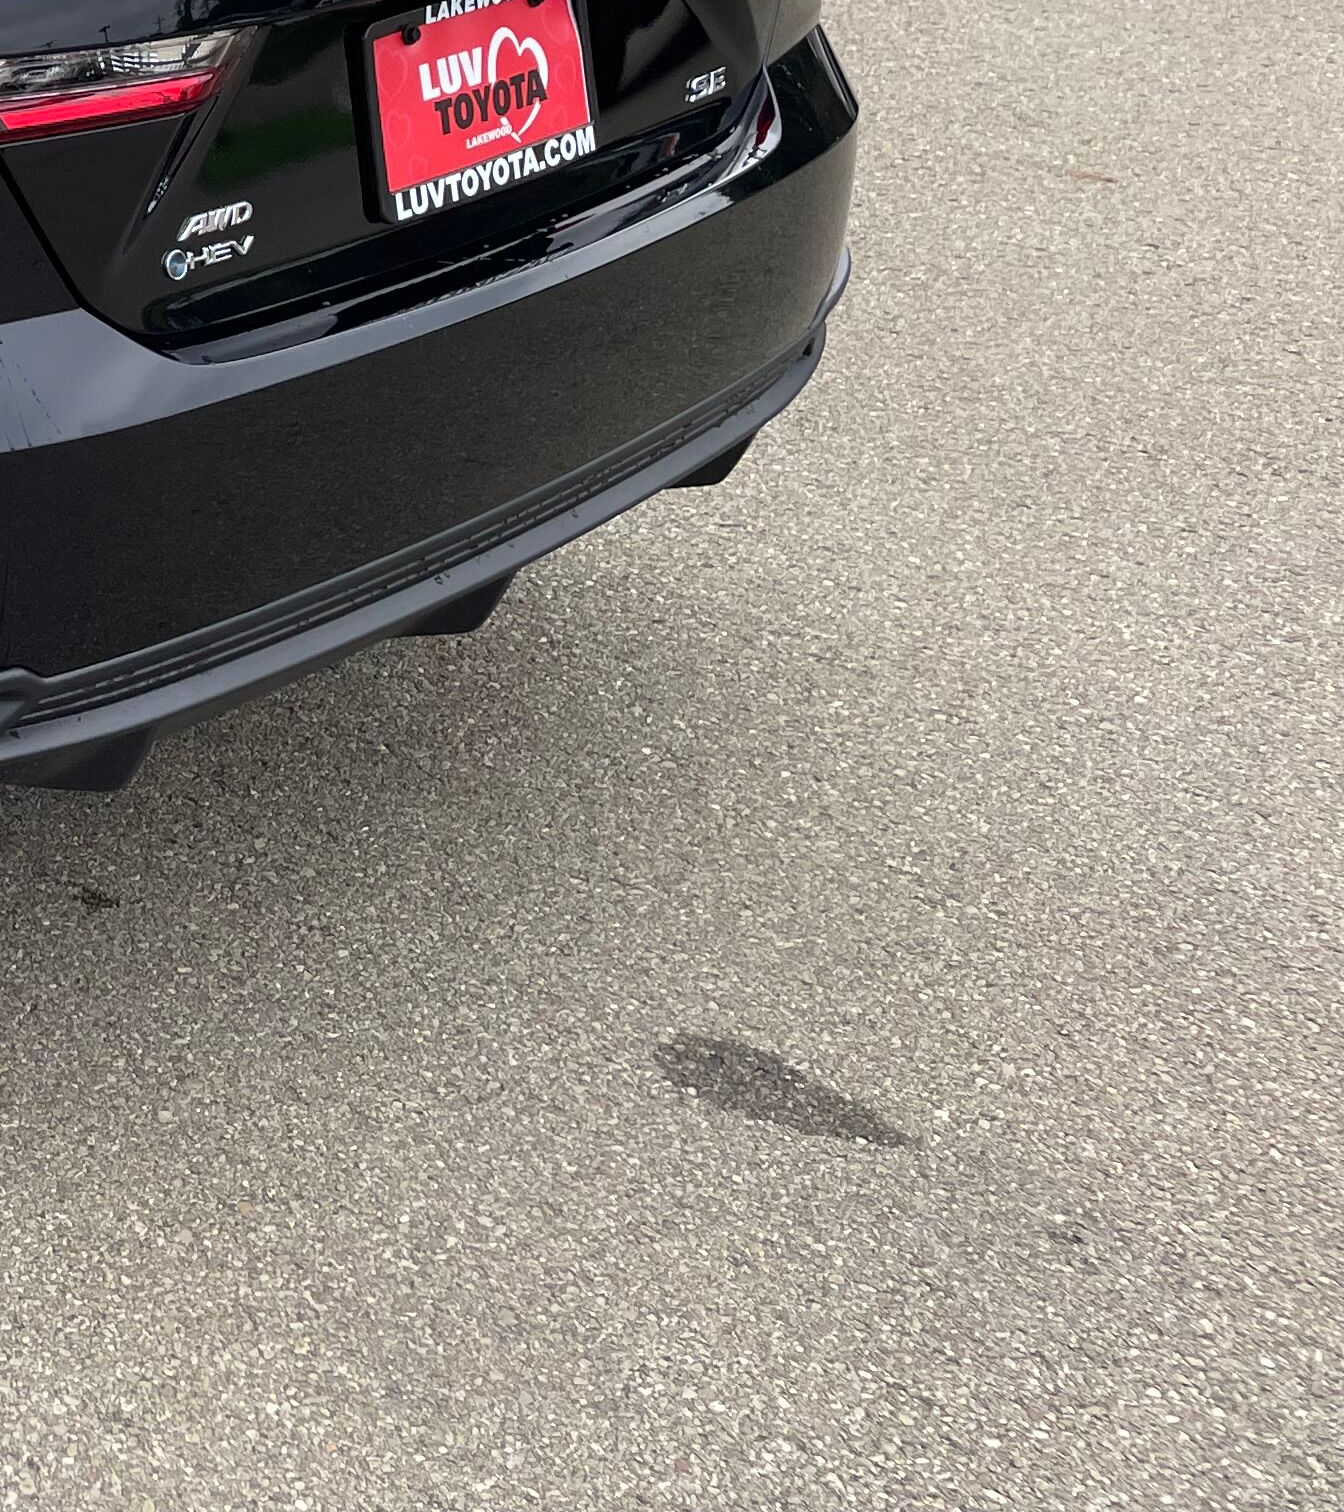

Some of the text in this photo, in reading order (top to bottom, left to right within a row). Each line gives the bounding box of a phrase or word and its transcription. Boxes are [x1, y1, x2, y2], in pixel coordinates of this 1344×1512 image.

[418, 46, 483, 102] LUV
[686, 66, 726, 103] SE
[434, 69, 548, 135] TOYOTA
[465, 123, 513, 149] LAKEWOOD
[395, 125, 597, 221] LUVTOYOTA.COM
[176, 201, 253, 242] AWD
[186, 235, 255, 270] HEV
